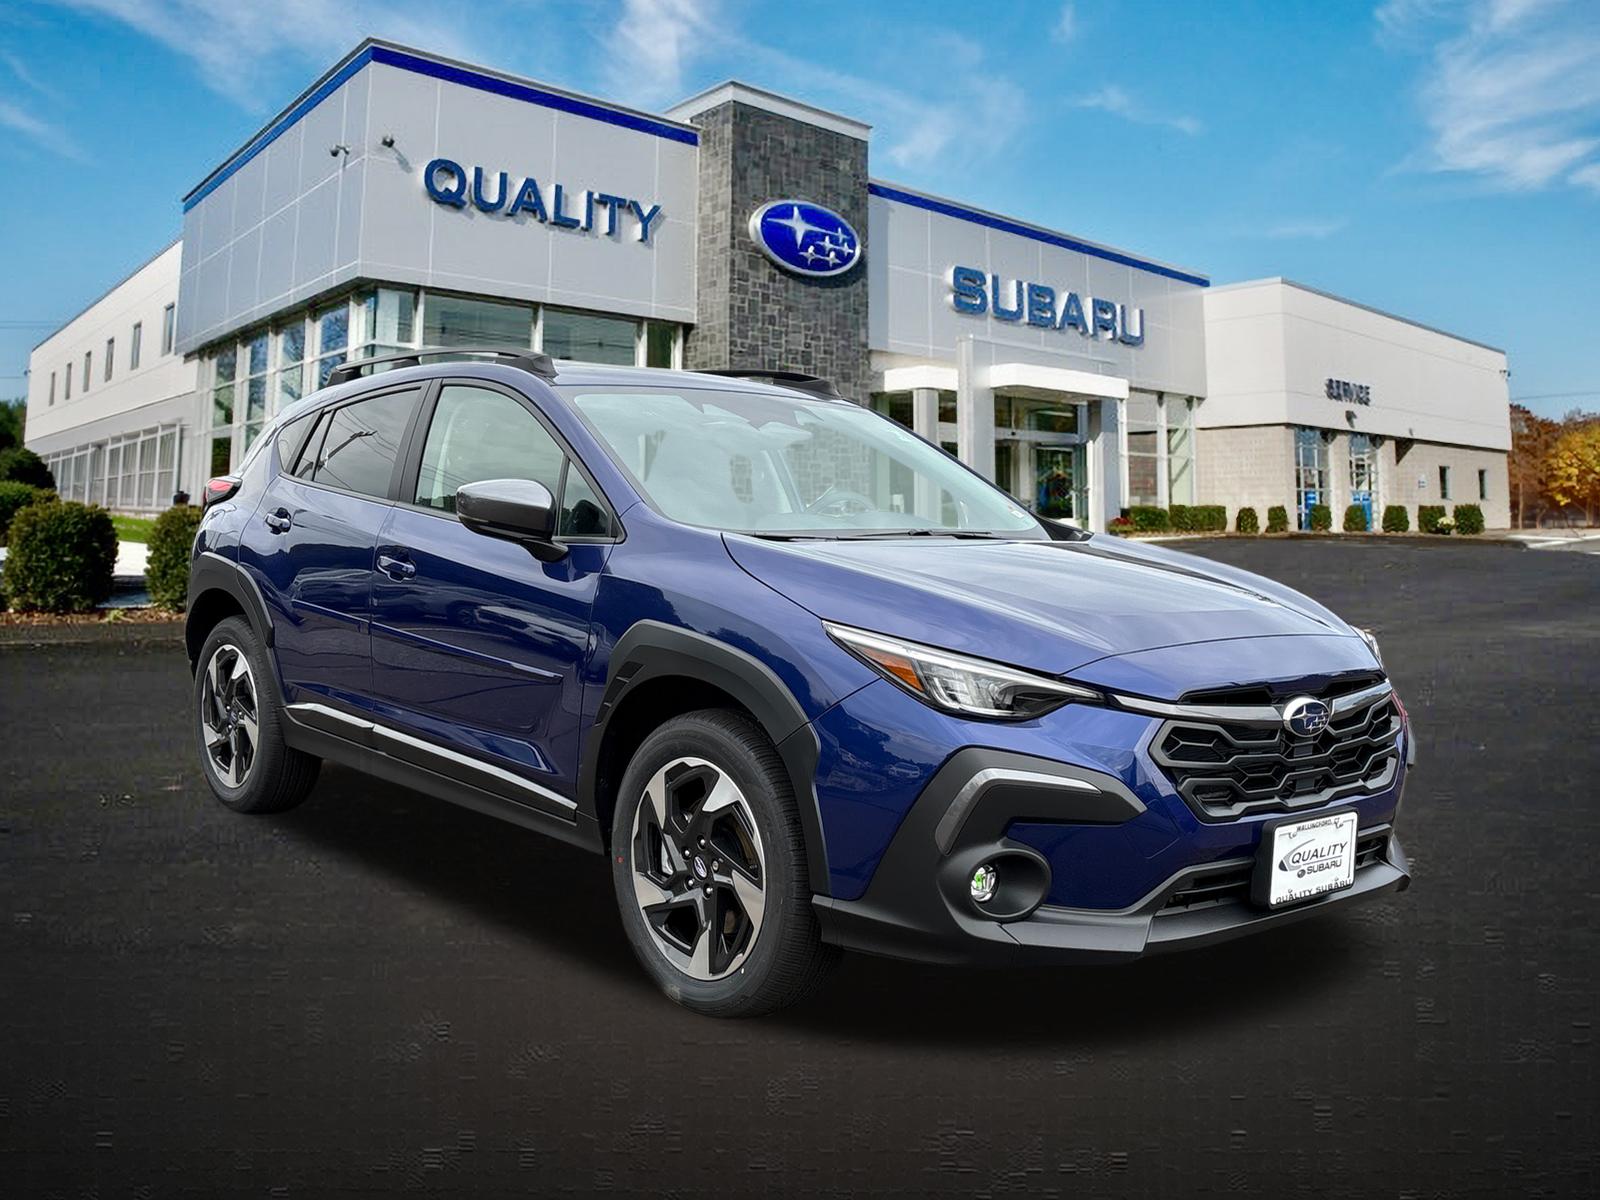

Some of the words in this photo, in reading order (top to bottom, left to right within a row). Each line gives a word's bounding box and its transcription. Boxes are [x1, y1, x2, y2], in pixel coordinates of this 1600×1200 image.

[423, 158, 662, 243] QUALITY
[950, 265, 1145, 347] SUBARU
[1291, 841, 1348, 864] QUALITY
[1306, 859, 1342, 875] SUBARU
[1276, 888, 1312, 904] QUALITY
[1316, 879, 1352, 893] SUBARU
